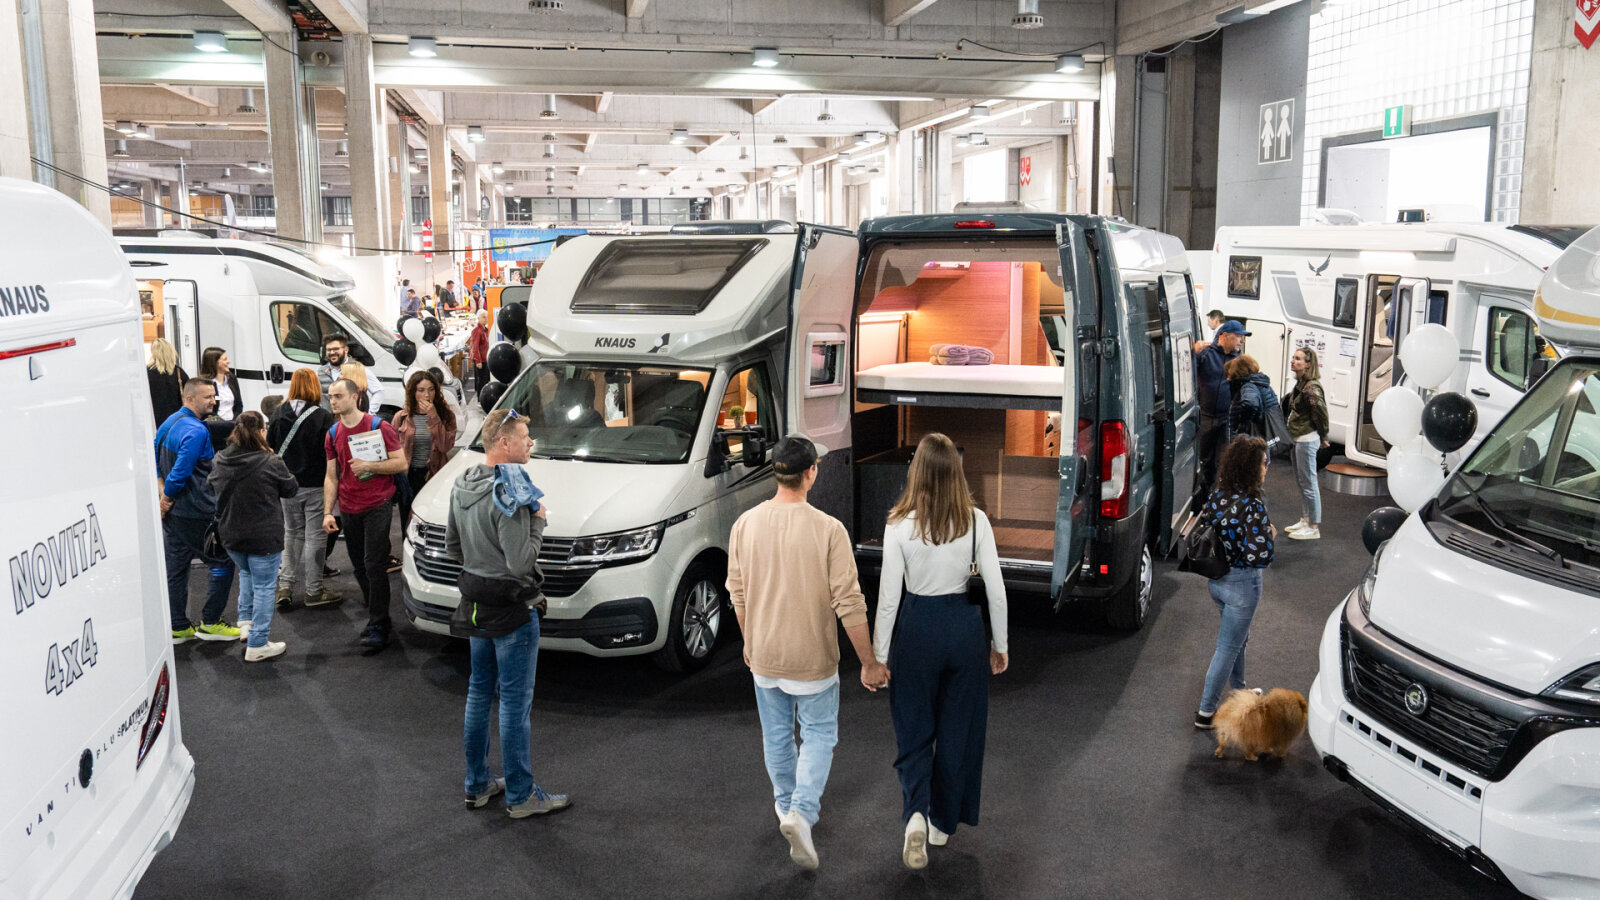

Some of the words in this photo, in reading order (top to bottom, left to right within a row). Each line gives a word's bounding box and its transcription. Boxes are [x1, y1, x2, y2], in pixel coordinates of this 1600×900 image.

[0, 284, 50, 317] NAUS
[594, 337, 637, 349] KNAUS
[9, 502, 107, 615] NOVITÀ
[45, 617, 99, 697] 4x4
[25, 799, 55, 837] VAN
